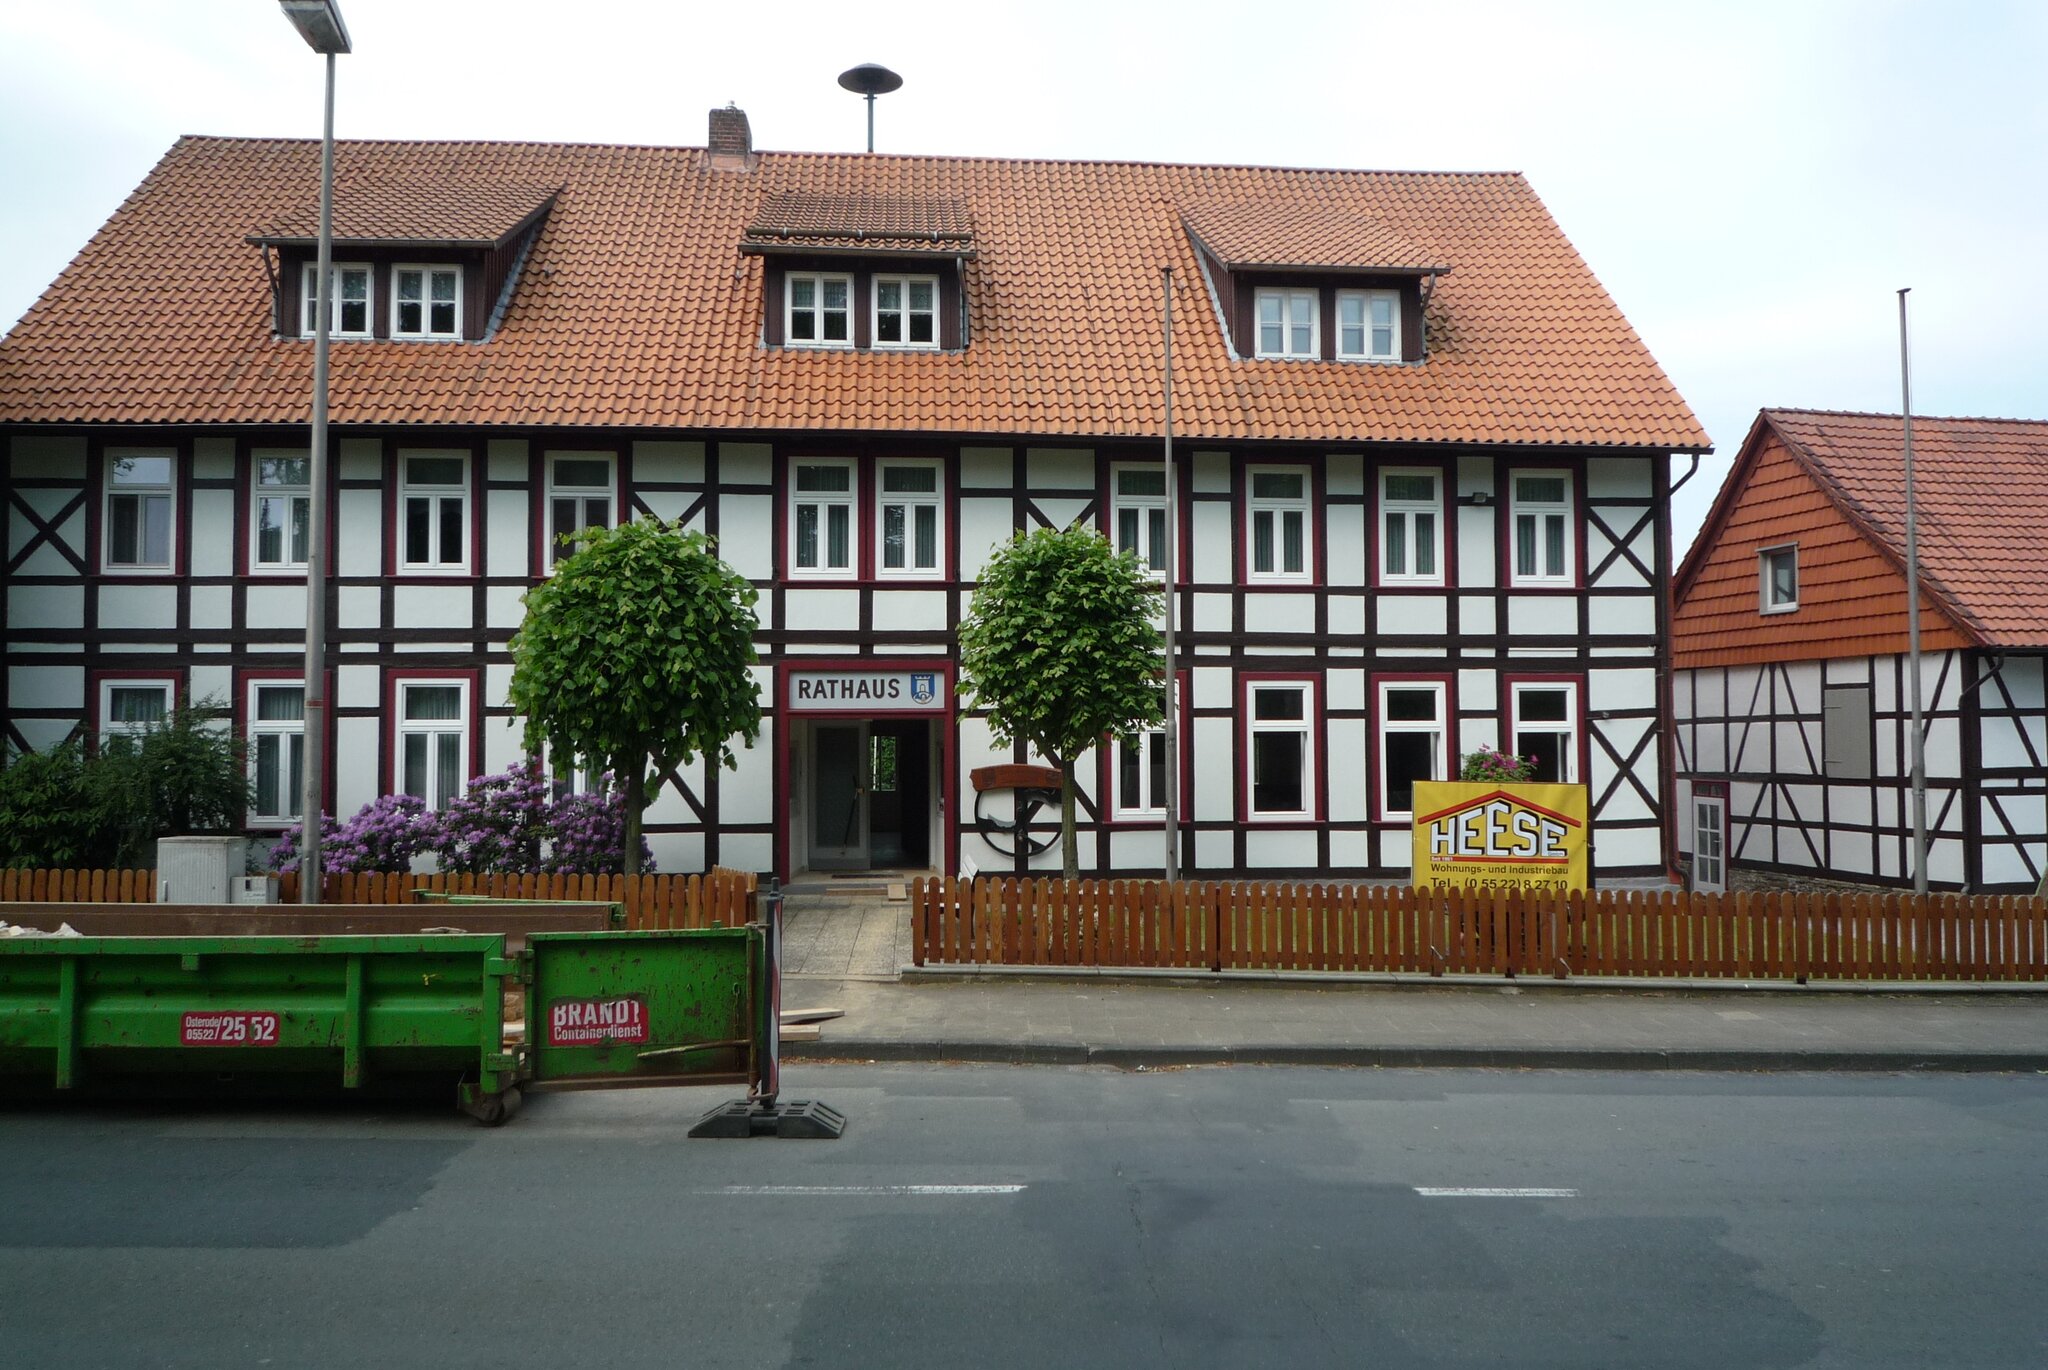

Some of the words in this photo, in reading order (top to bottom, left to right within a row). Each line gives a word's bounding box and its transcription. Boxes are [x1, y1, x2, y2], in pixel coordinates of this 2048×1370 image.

[798, 679, 900, 699] RATHAUS
[1430, 799, 1568, 857] HEESE
[1431, 863, 1486, 875] Wohnungs-
[1488, 865, 1507, 874] und
[1509, 865, 1569, 875] Industriebau
[1481, 879, 1497, 889] 55
[1534, 880, 1551, 890] 27
[1553, 880, 1568, 889] 10
[221, 1016, 246, 1040] 25
[554, 1024, 642, 1041] Containerdienst
